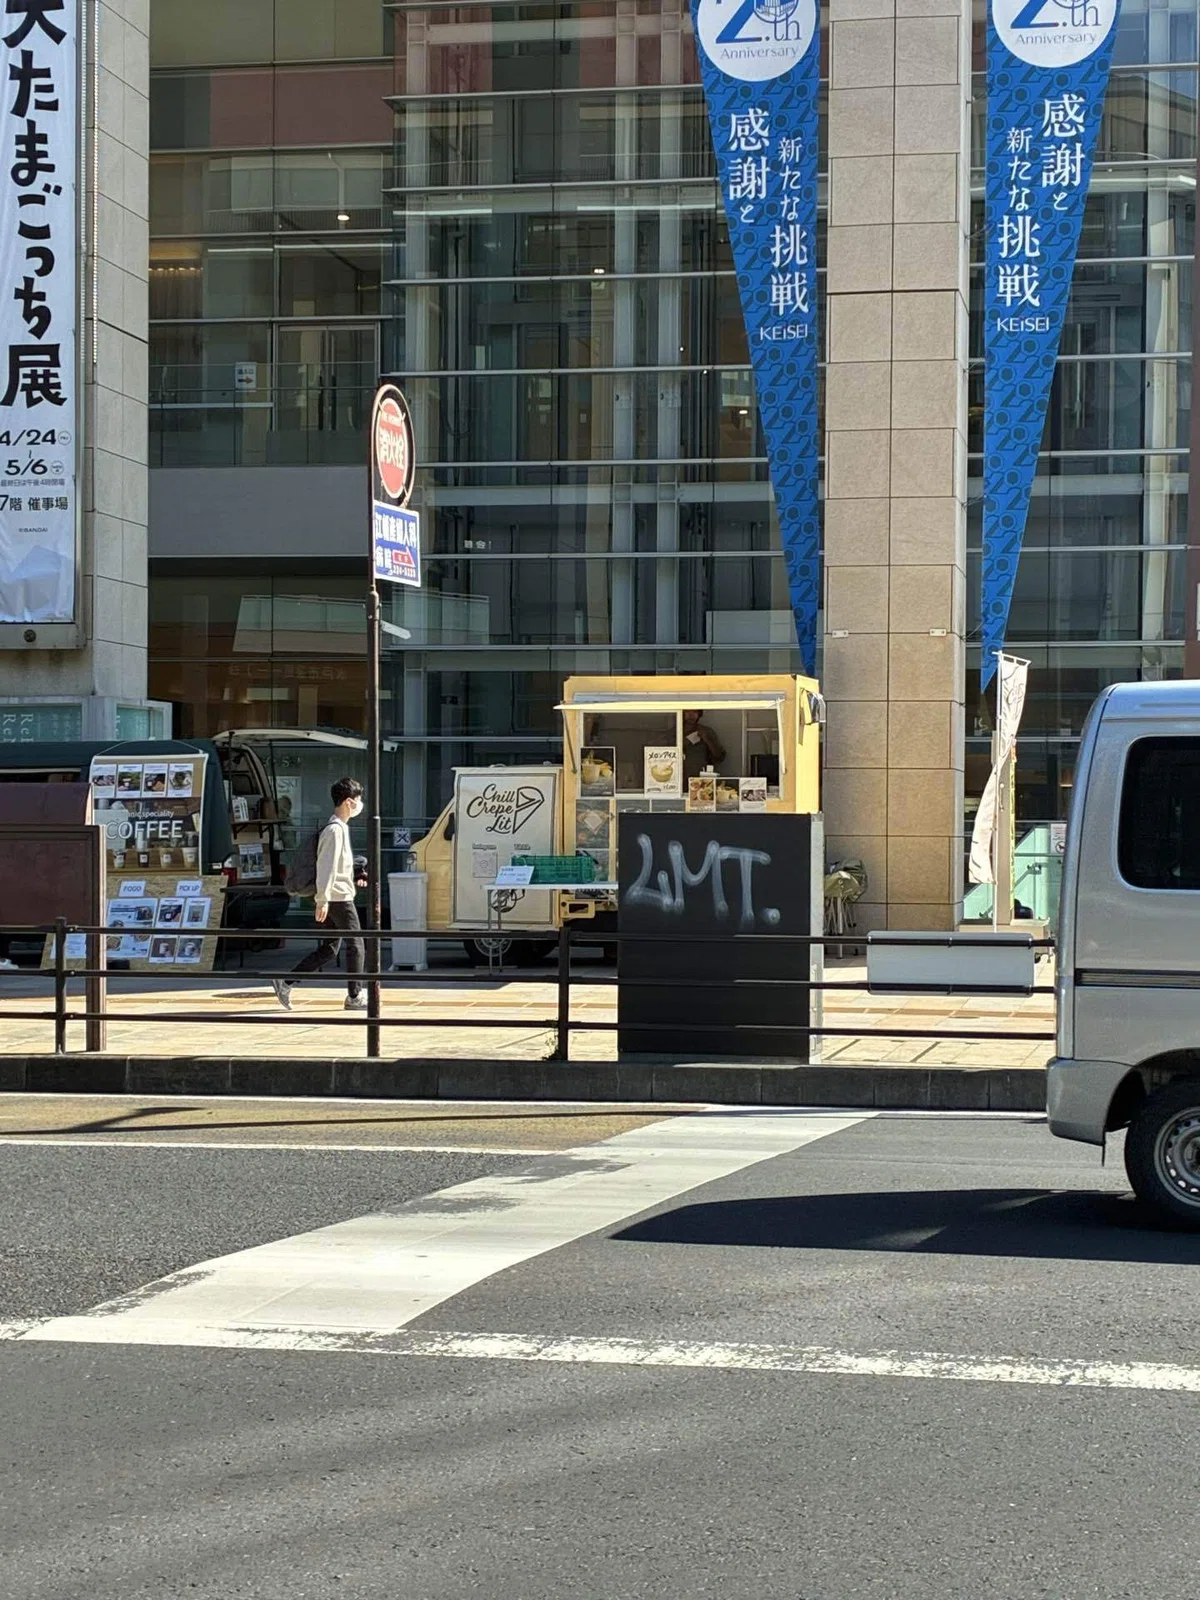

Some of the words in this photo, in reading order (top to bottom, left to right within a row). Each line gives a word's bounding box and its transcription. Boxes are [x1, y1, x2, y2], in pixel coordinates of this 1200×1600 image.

[1015, 32, 1097, 46] Anniversary
[720, 45, 799, 60] Anniversary
[1041, 94, 1085, 211] 感謝と
[728, 107, 771, 224] 感謝と
[0, 0, 67, 409] 大たまごっち展
[769, 136, 809, 316] 新たな挑戦
[997, 126, 1041, 309] 新たな挑戦
[0, 428, 57, 447] 4/24
[4, 459, 48, 476] 5/6
[28, 496, 68, 511] 催事場
[483, 783, 516, 803] Chill
[467, 796, 514, 818] Crepe
[106, 819, 183, 839] COFFEE
[486, 813, 512, 835] Lit
